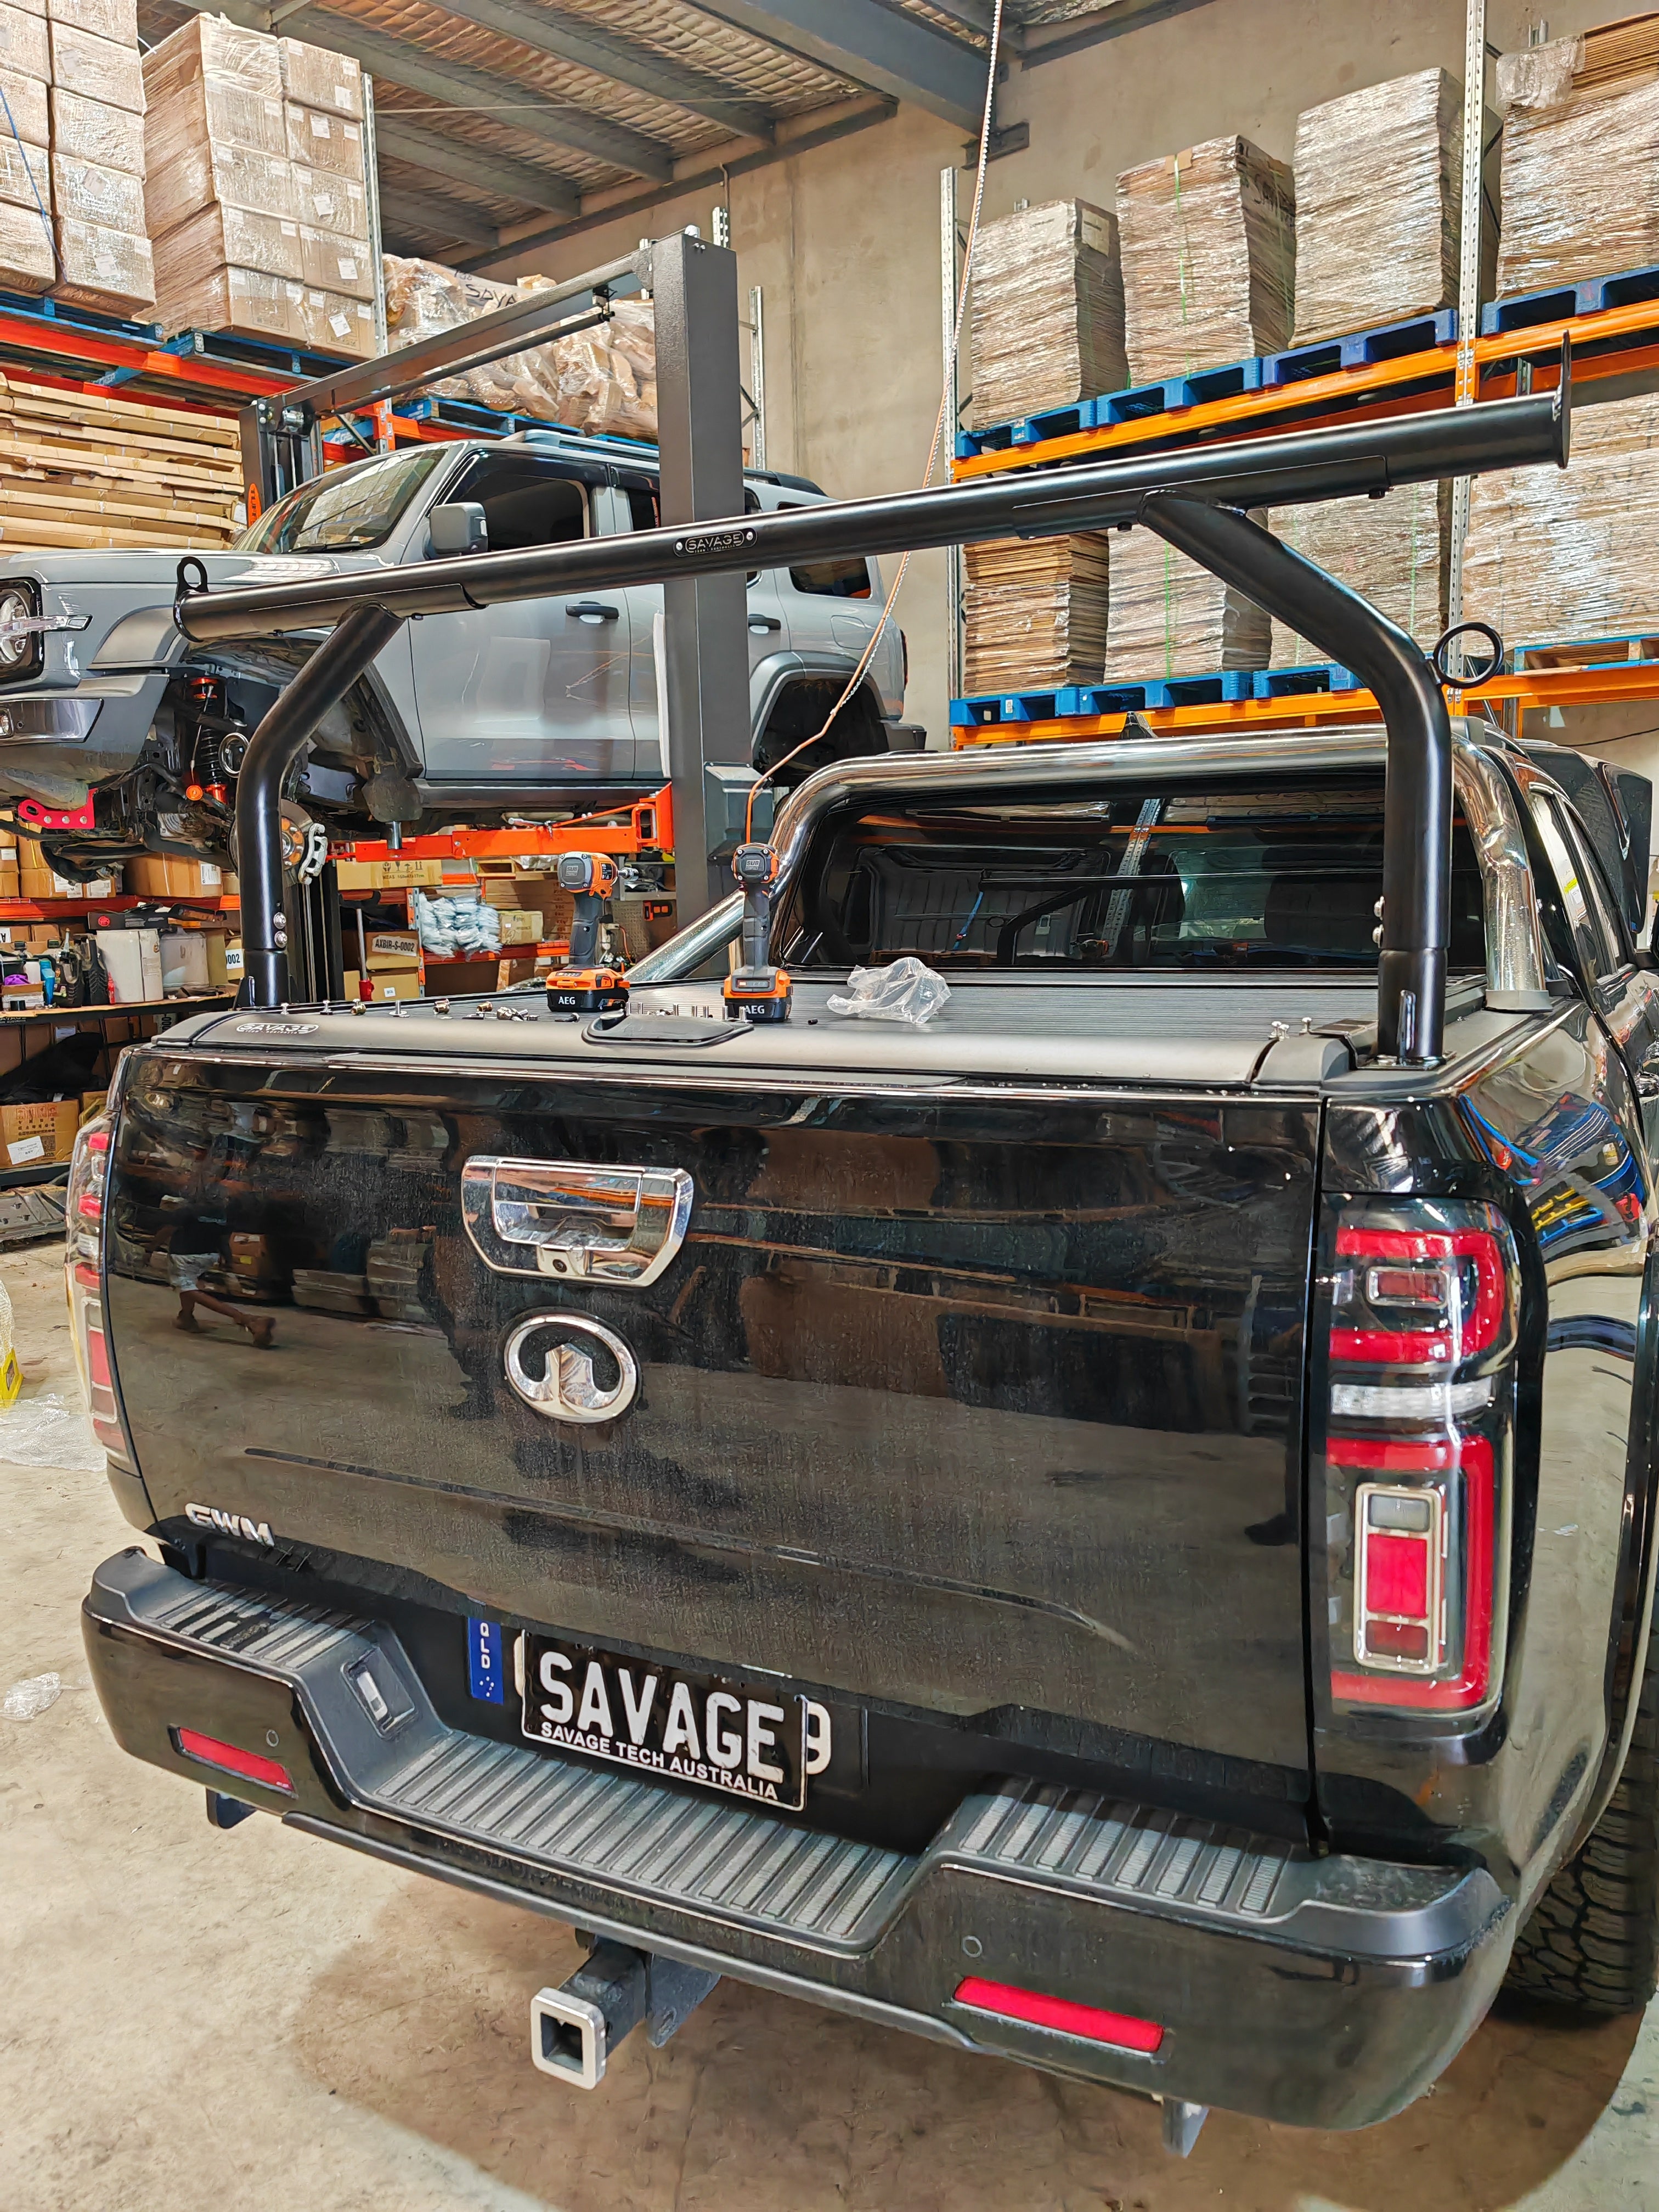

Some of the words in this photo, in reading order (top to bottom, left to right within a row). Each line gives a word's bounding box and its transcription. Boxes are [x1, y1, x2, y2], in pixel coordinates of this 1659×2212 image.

[688, 533, 741, 550] SAVAGE
[226, 953, 241, 964] 002
[558, 996, 575, 1005] AEG
[745, 1005, 765, 1014] AEG
[240, 1024, 314, 1032] SAVAGE
[185, 1503, 275, 1547] GWM
[480, 1622, 490, 1669] QLD
[540, 1651, 785, 1784] SAVAGE
[541, 1722, 611, 1754] SAVAGE
[615, 1741, 664, 1768] TECH
[669, 1757, 778, 1801] AUSTRALIA
